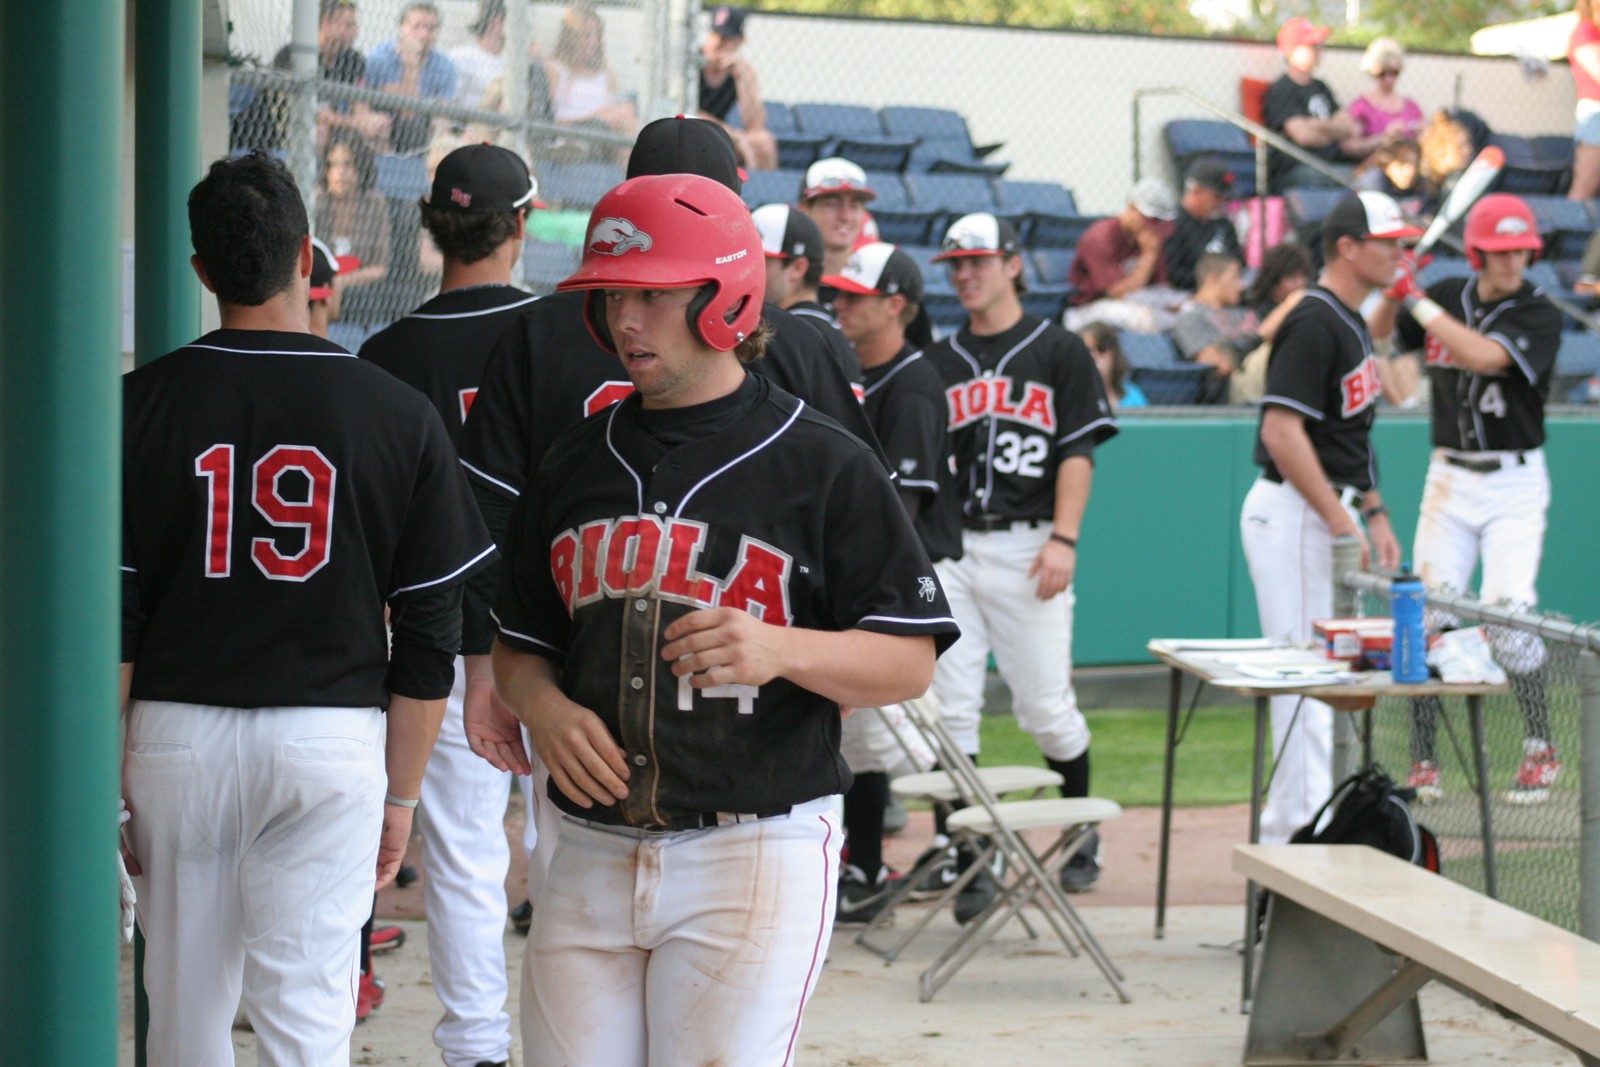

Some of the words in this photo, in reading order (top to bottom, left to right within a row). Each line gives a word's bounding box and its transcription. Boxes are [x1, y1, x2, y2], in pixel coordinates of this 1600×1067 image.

[715, 249, 747, 264] EASTON
[945, 377, 1057, 436] IOLA
[1479, 382, 1508, 418] 4
[993, 431, 1049, 478] 32
[195, 443, 337, 582] 19
[551, 513, 794, 628] BIOLA
